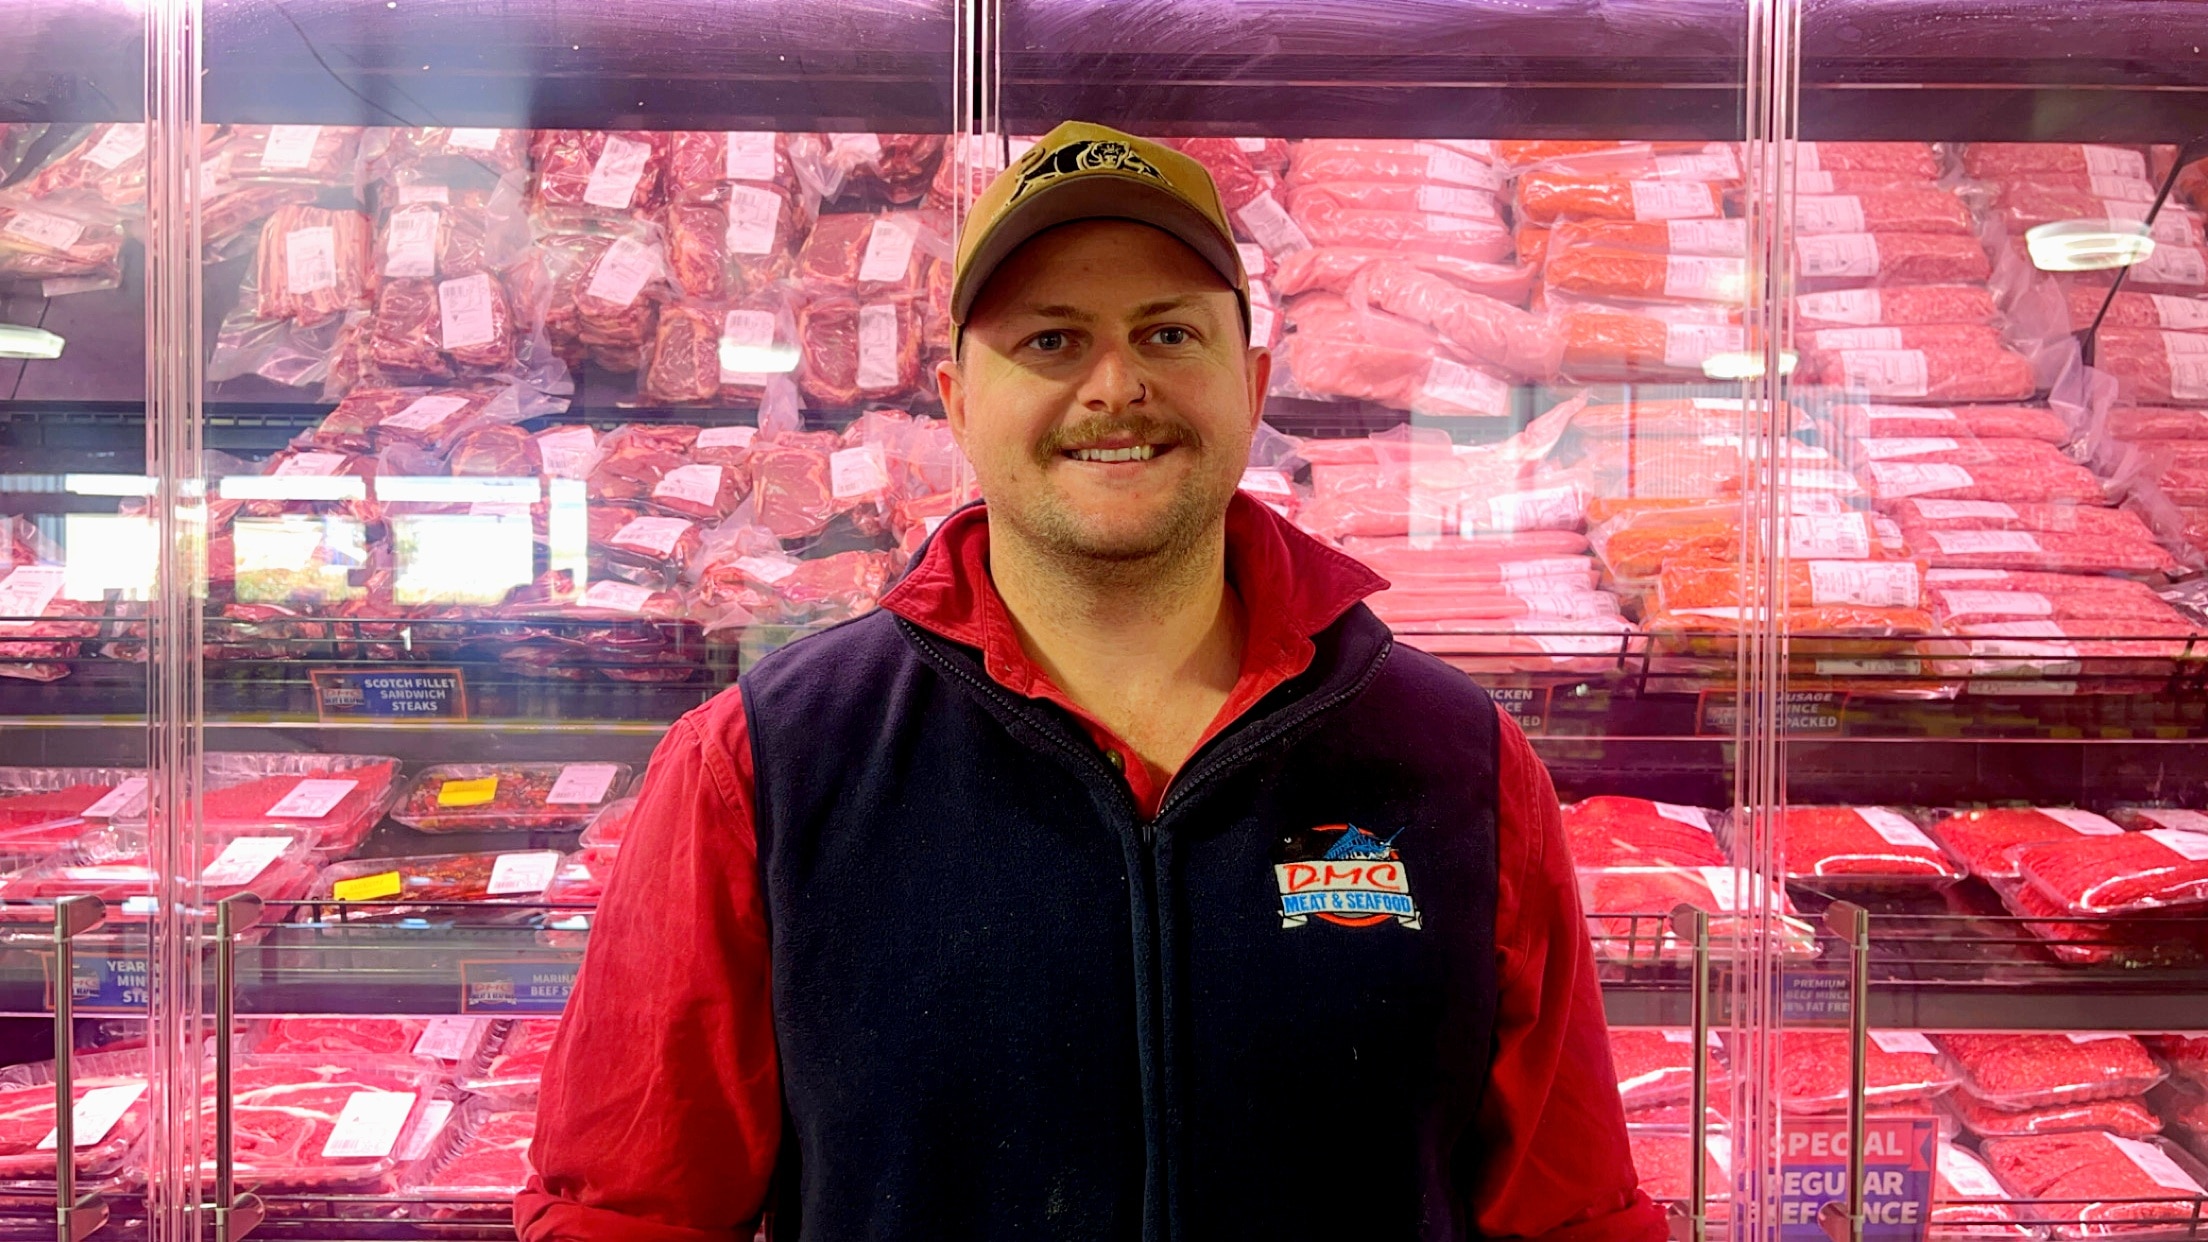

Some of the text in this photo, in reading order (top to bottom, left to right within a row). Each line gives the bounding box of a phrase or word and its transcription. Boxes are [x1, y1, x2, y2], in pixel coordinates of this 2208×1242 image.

[364, 678, 456, 689] SCOTCH FILLET
[380, 689, 446, 699] SANDWICH
[392, 701, 438, 711] STEAKS
[1283, 863, 1400, 892] DMC
[1283, 892, 1411, 913] MEAT & SEAFOOD
[106, 960, 158, 972] YEAR
[1792, 978, 1846, 989] PREMIUM
[530, 985, 559, 997] BEEF
[1785, 989, 1812, 1000] BEEF
[1805, 1002, 1825, 1013] FAT
[1827, 1002, 1850, 1013] FRE
[1768, 1131, 1904, 1158] SPECAL
[1861, 1201, 1920, 1225] NCE
